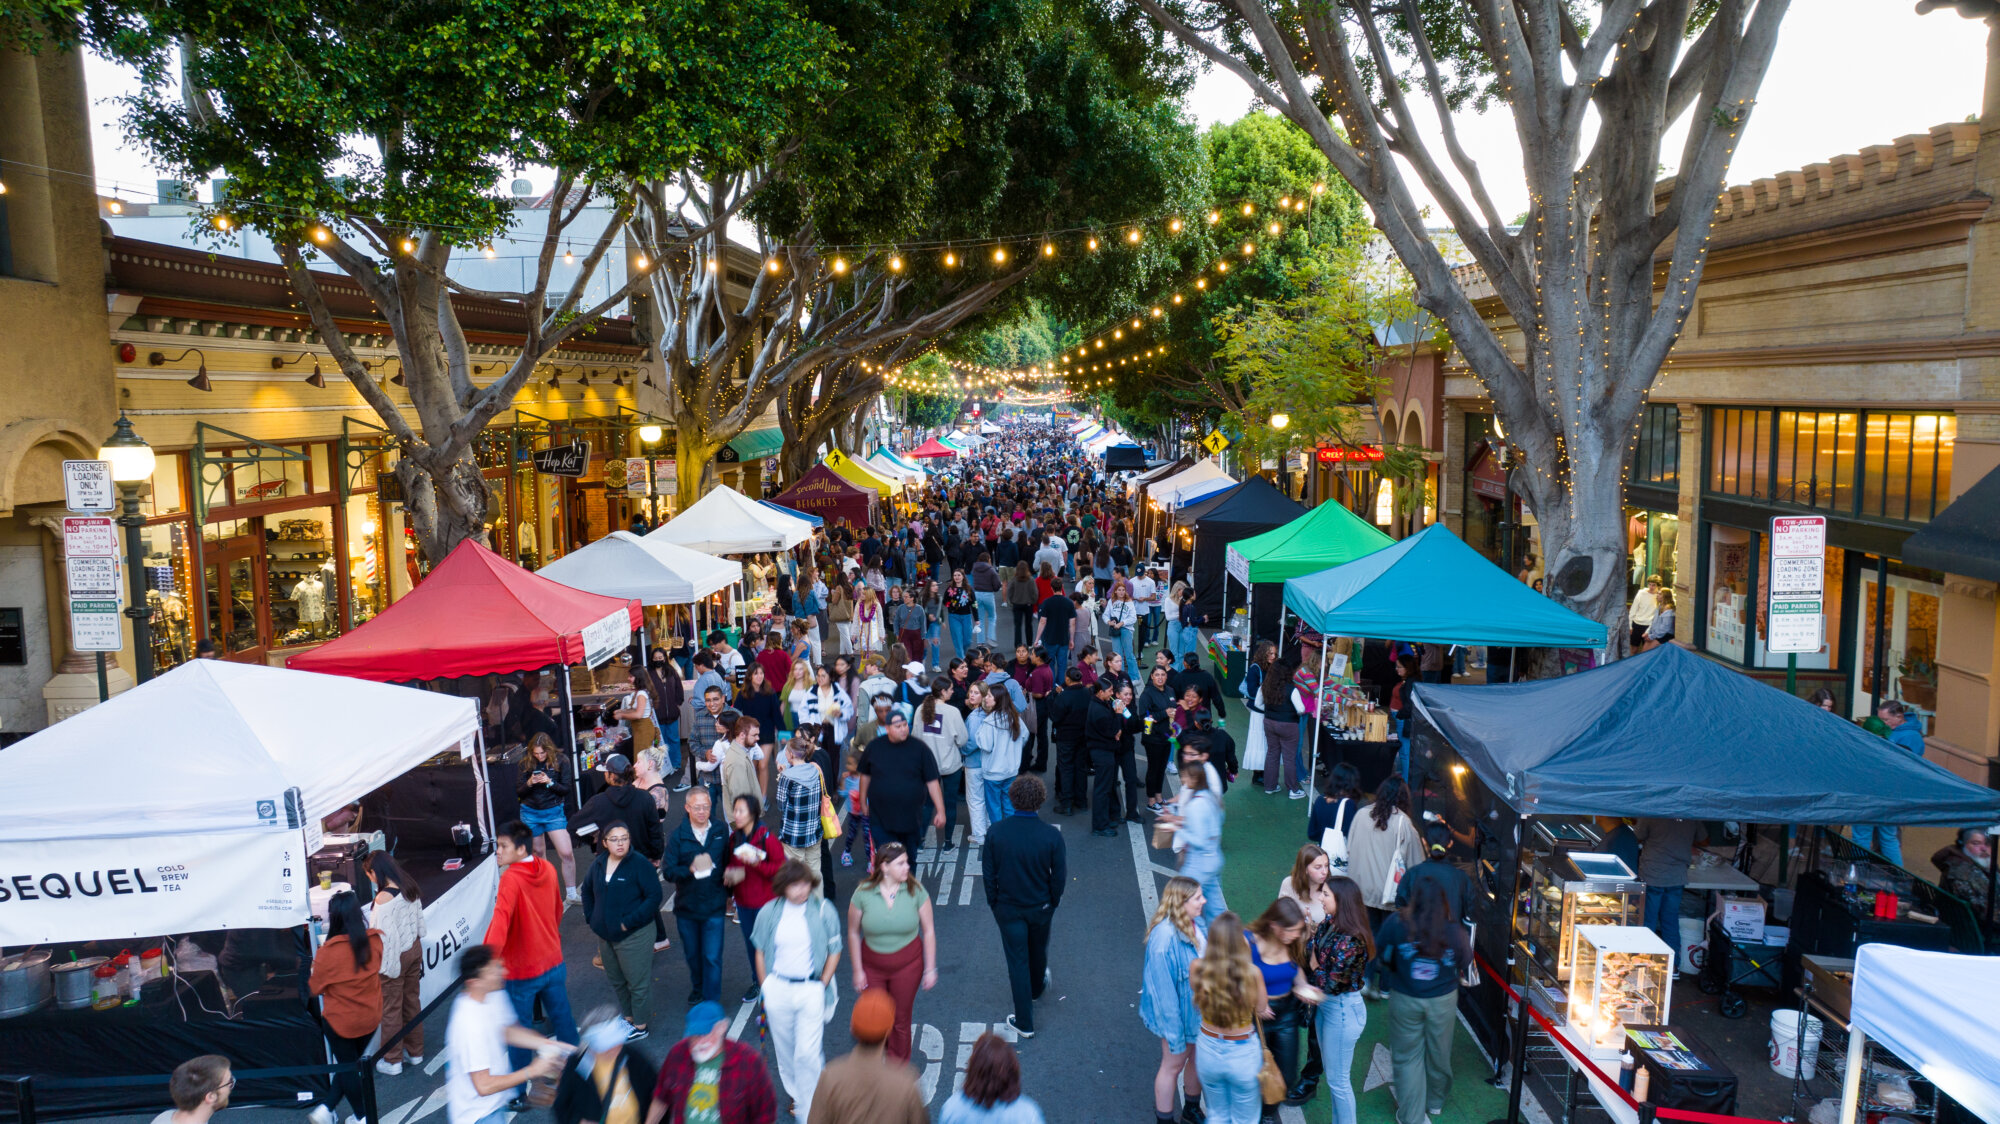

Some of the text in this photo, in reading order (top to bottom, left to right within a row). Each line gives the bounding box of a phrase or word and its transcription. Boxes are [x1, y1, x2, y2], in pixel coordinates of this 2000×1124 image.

[536, 451, 584, 472] Hep Kat
[80, 481, 98, 489] ONLY
[824, 478, 842, 493] Line
[796, 497, 838, 509] BEIGNETS
[161, 873, 189, 881] BREW
[419, 930, 461, 980] UEL
